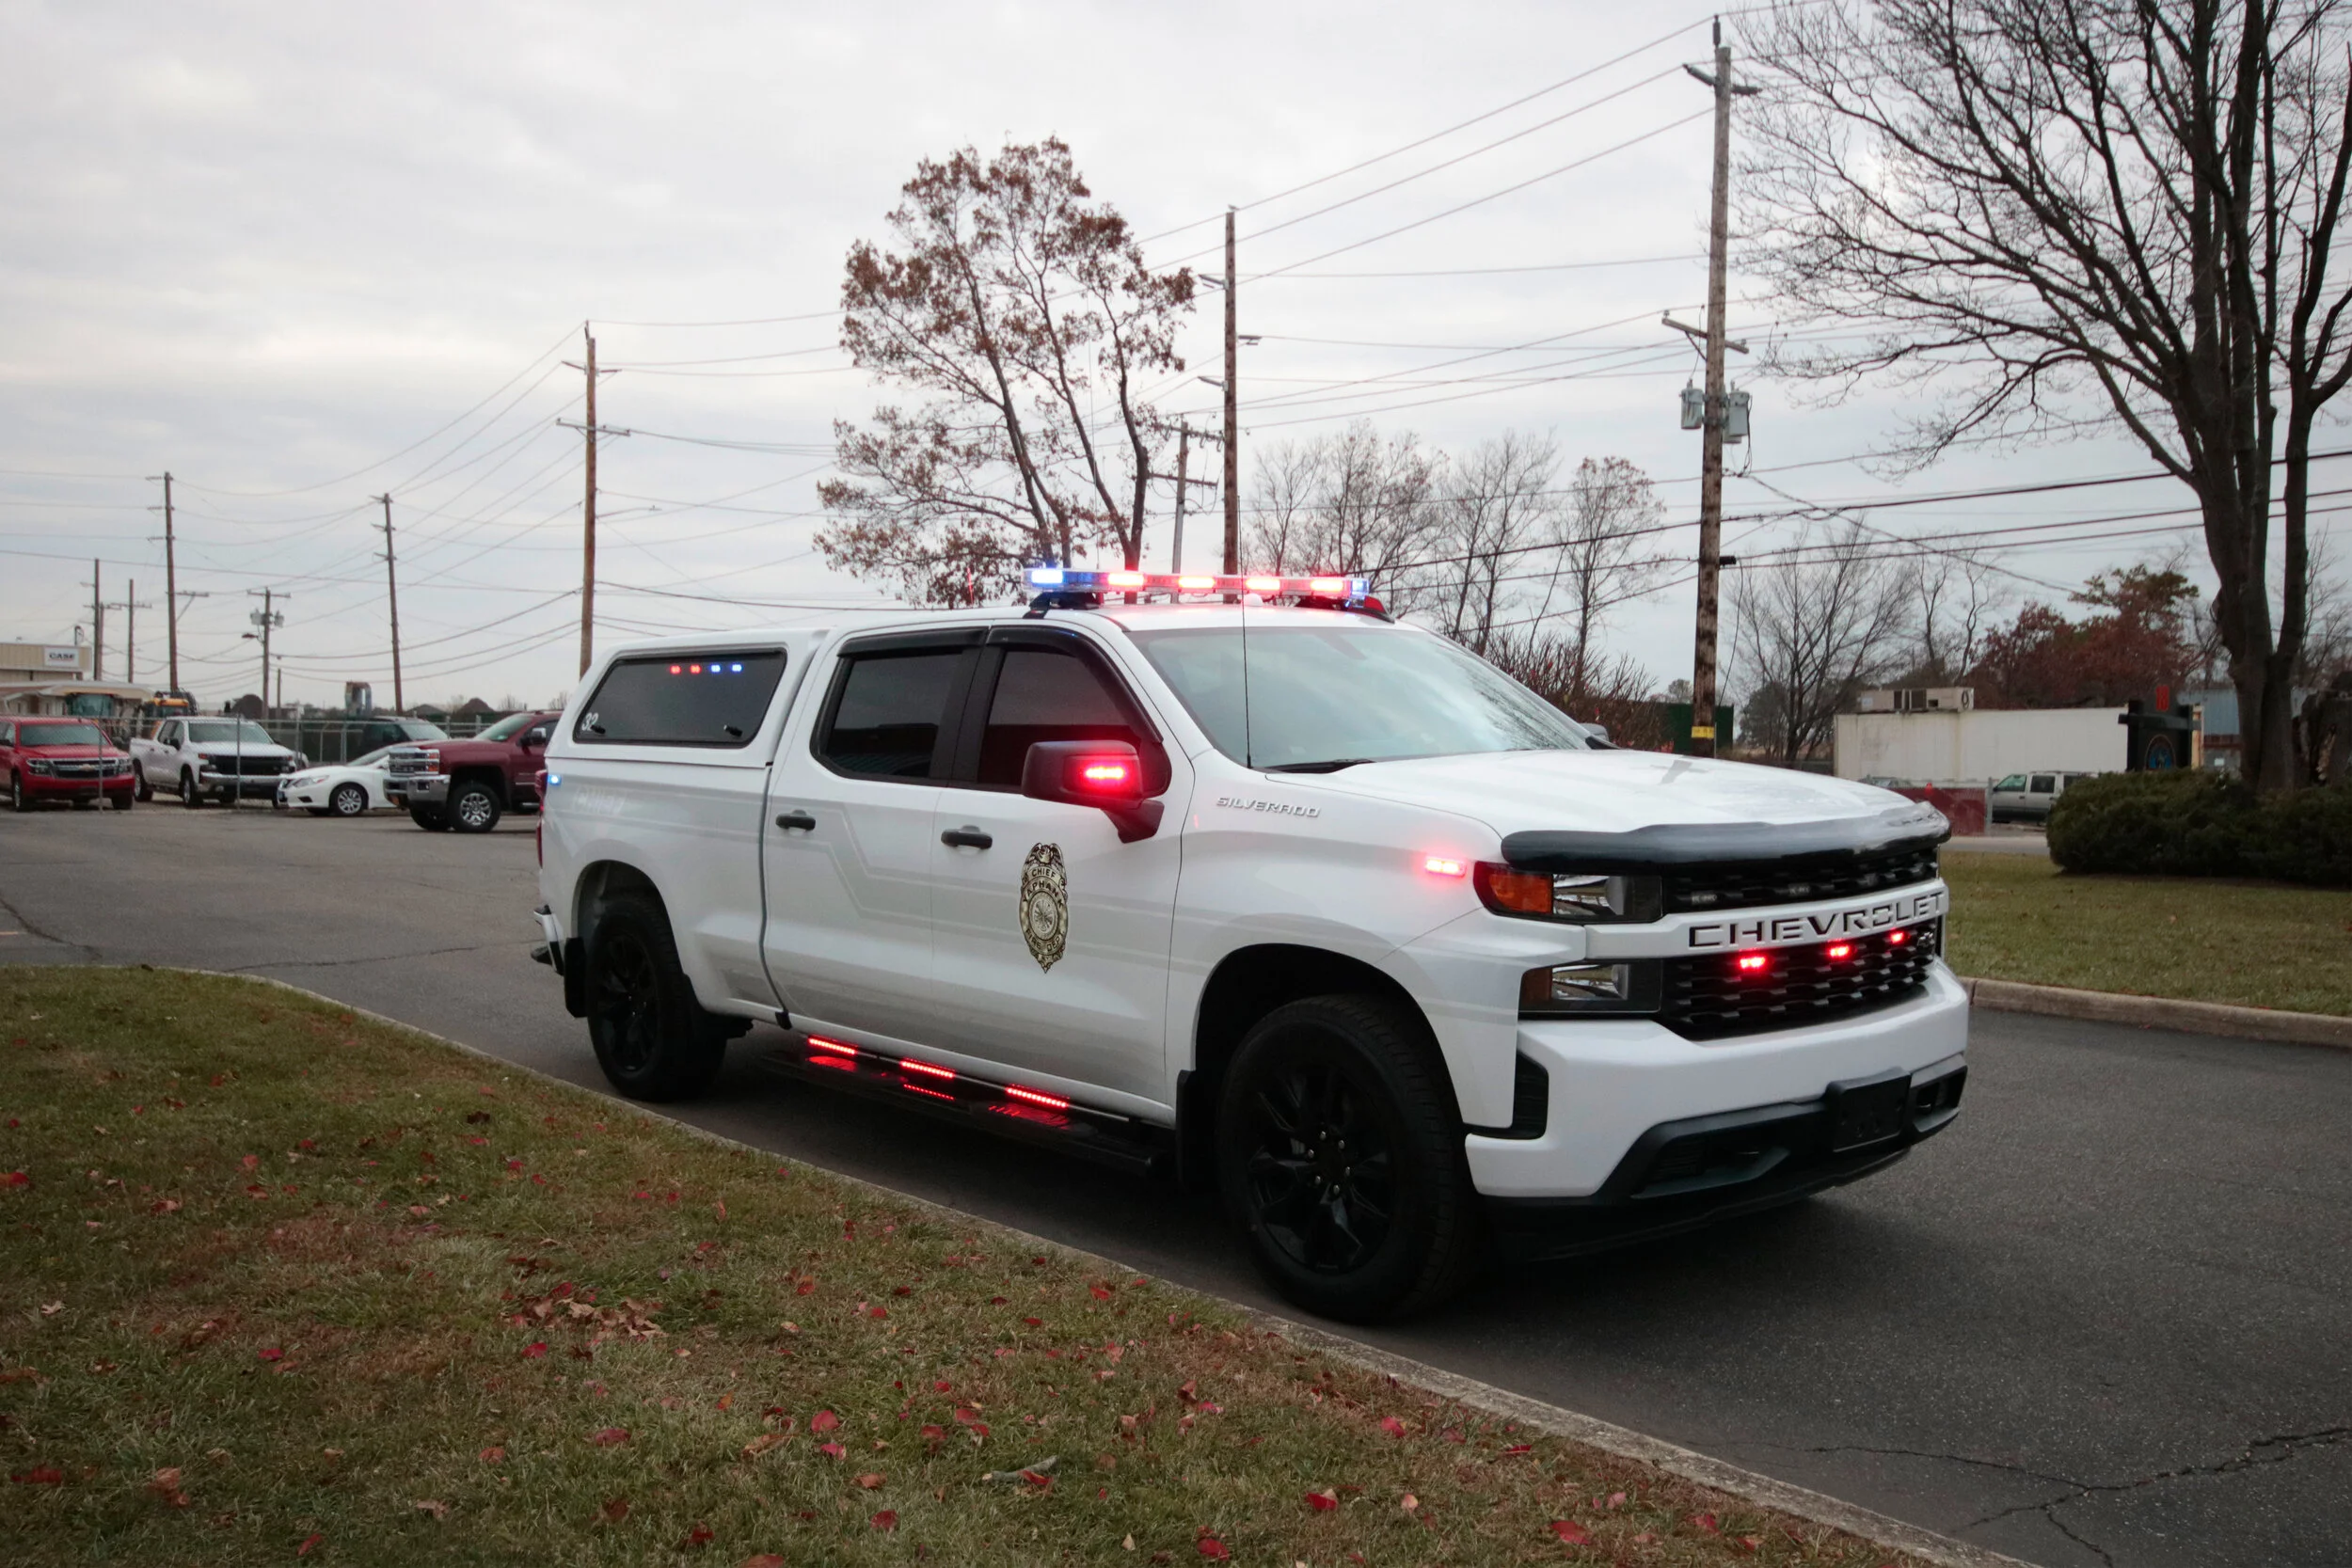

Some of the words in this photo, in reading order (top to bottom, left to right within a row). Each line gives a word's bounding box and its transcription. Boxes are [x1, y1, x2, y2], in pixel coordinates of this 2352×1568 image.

[1216, 797, 1321, 818] SILVERADO
[1031, 867, 1056, 878] CHIEF
[1023, 880, 1064, 909] YAPHANK
[1689, 892, 1946, 948] CHEVROLET
[1025, 928, 1041, 949] FIRE
